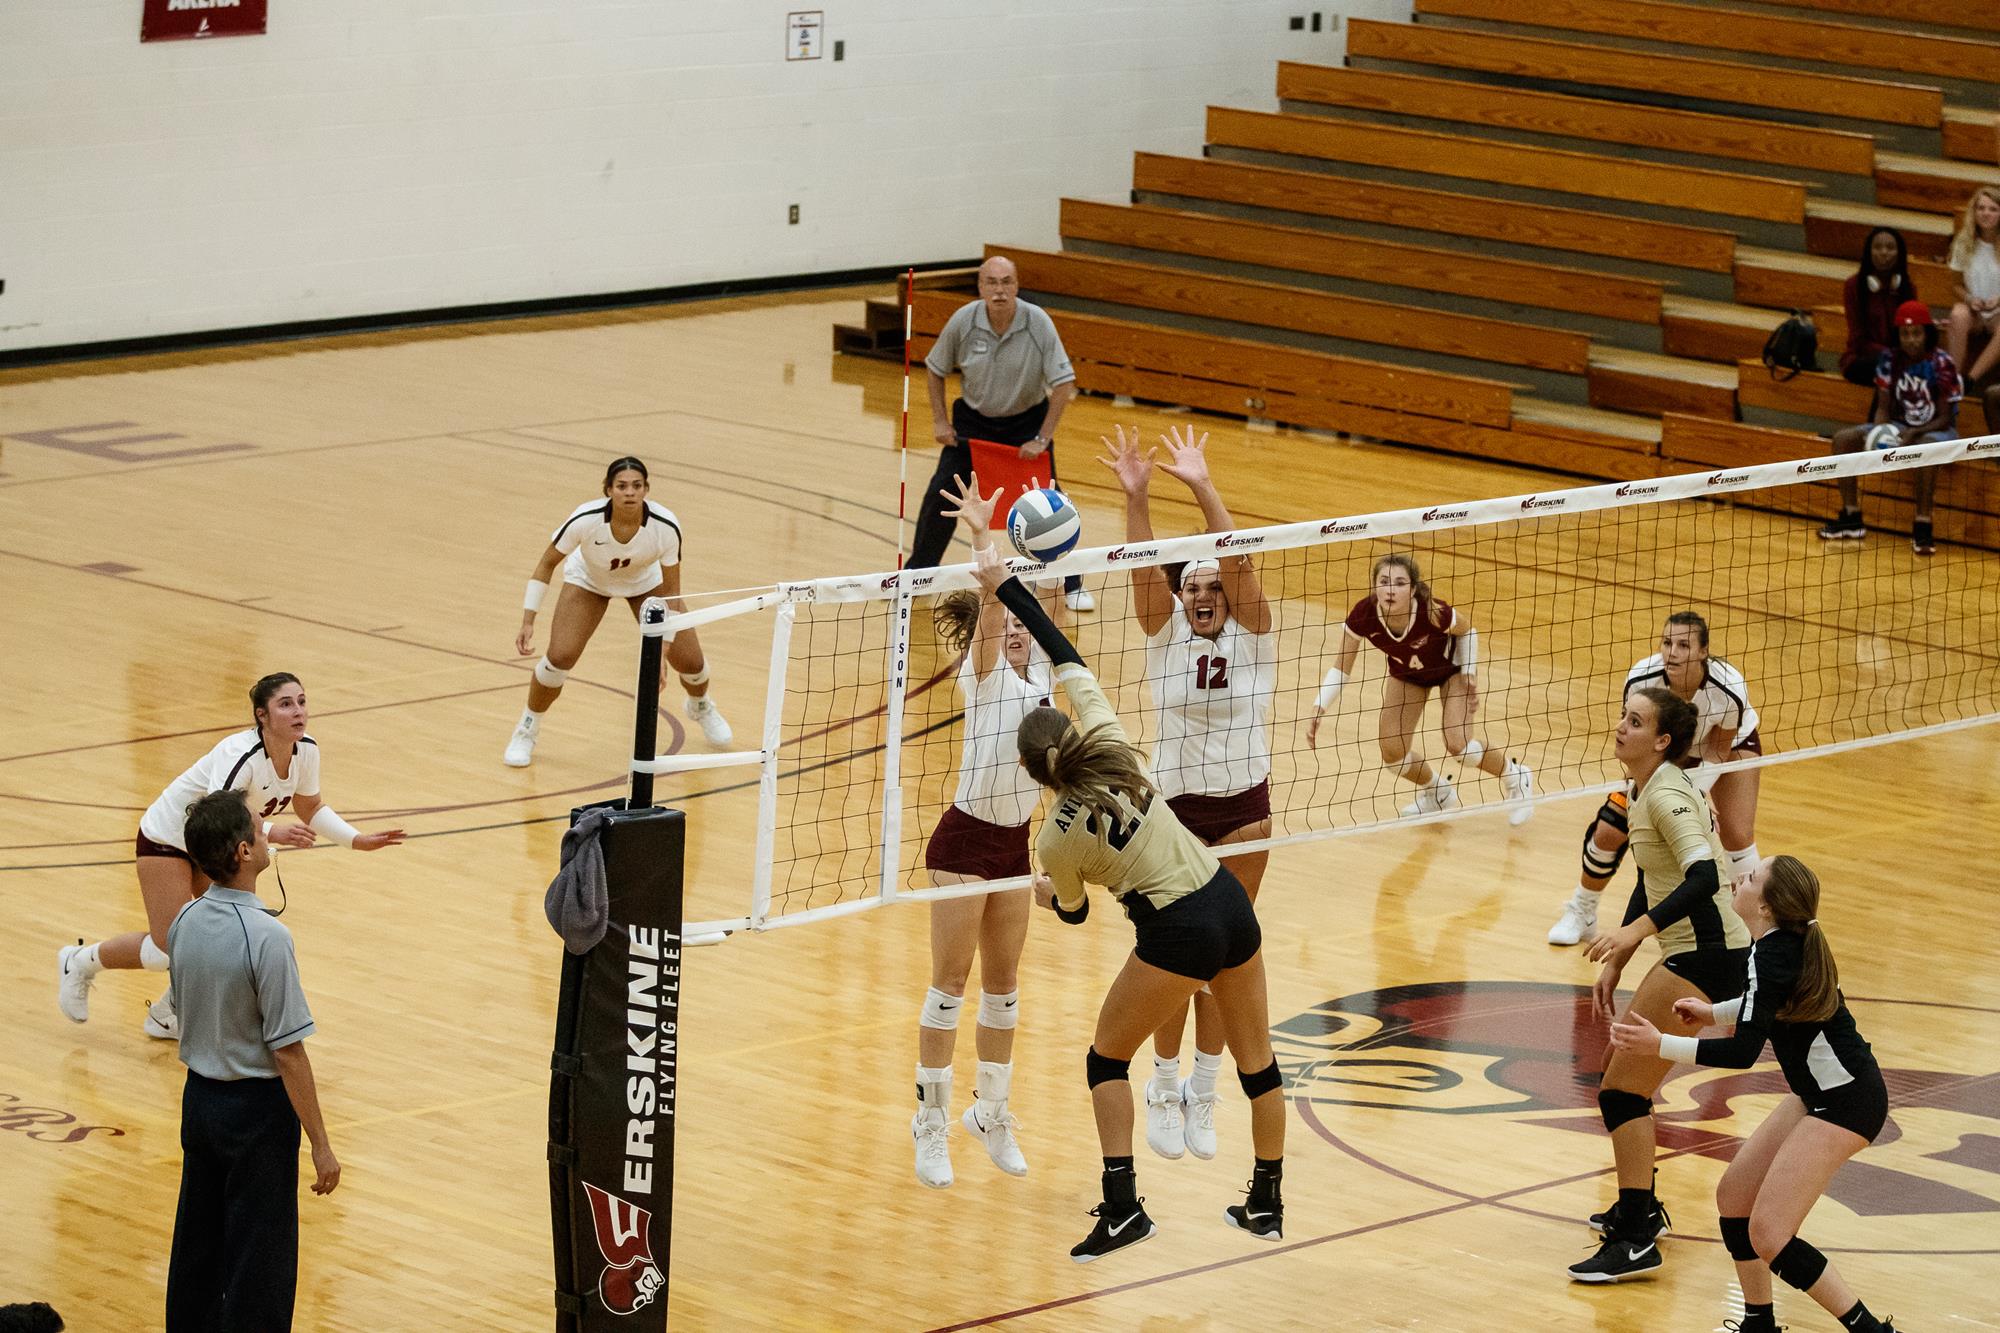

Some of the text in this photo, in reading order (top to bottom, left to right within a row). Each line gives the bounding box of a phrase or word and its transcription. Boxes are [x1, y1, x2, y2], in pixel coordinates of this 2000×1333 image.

[1629, 486, 1660, 496] ERSKINE
[1533, 498, 1566, 508] ERSKINE
[1435, 511, 1469, 521] ERSKINE
[1334, 523, 1368, 533] ERSKINE
[1230, 536, 1265, 546] ERSKINE
[1122, 549, 1159, 560] ERSKINE
[1011, 561, 1047, 574] ERSKINE
[896, 608, 908, 688] BISON
[1196, 654, 1229, 690] 12
[659, 929, 681, 1116] FLYING FLEET
[623, 924, 660, 1195] ERSKINE
